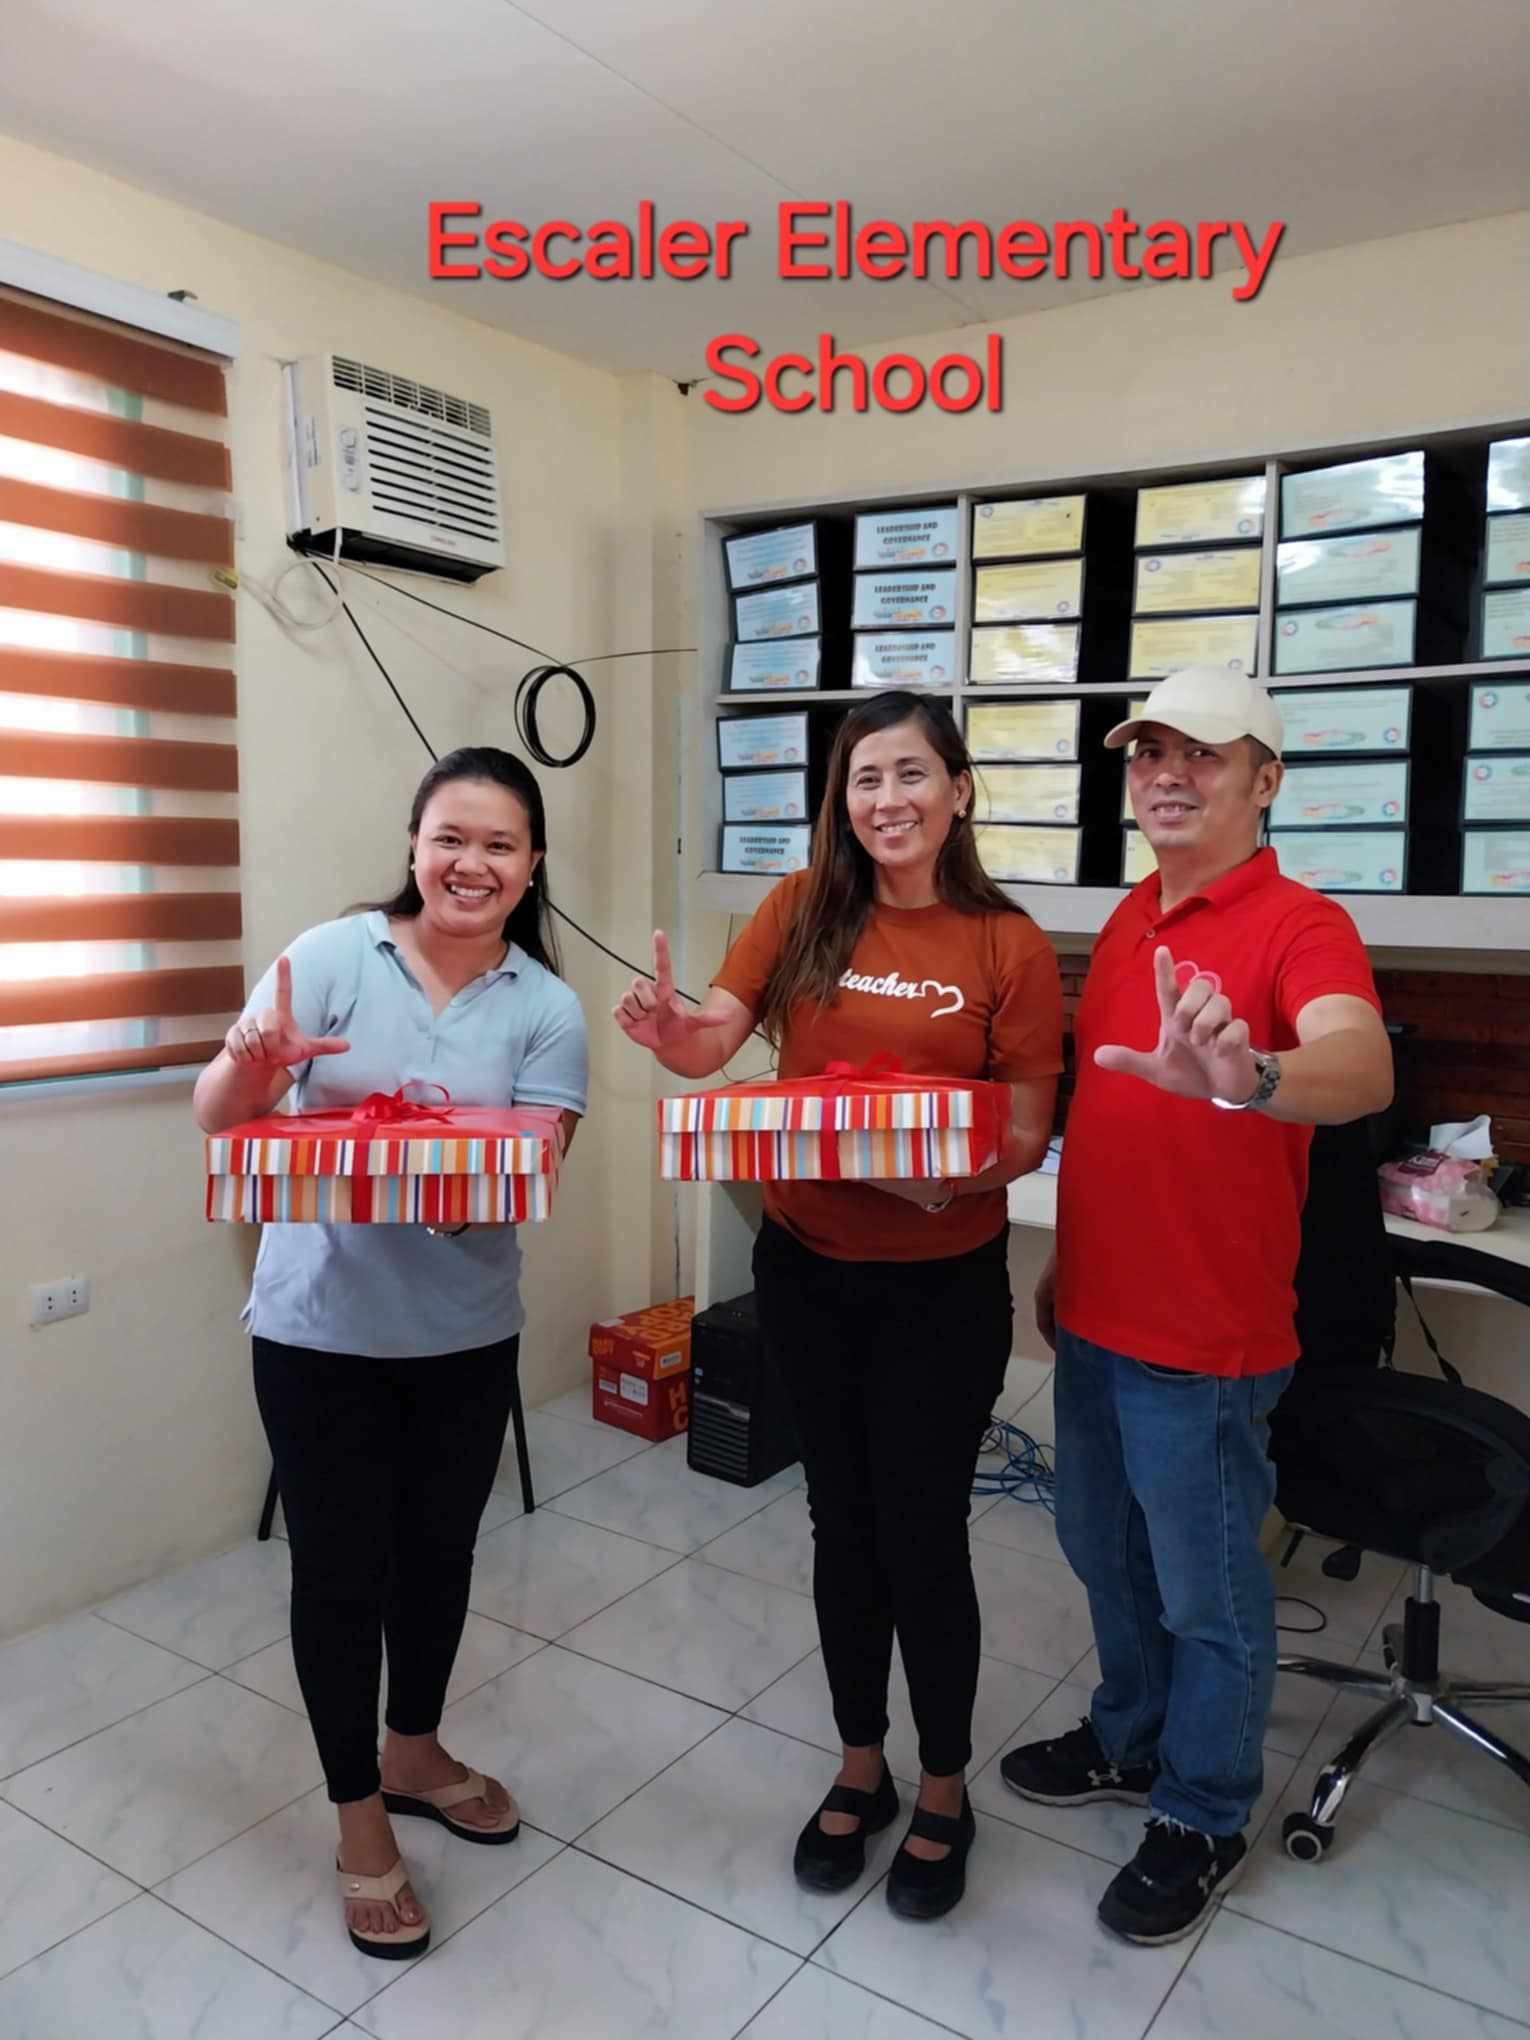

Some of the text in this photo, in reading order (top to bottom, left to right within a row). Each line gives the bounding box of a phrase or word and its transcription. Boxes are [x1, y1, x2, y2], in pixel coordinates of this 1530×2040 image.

[876, 521, 938, 534] LEADERSHIP AND
[883, 534, 930, 544] GOVERNANCE
[874, 583, 936, 593] LEADERSHIP AND
[880, 595, 928, 604] GOVERNANCE
[838, 968, 920, 999] teacher
